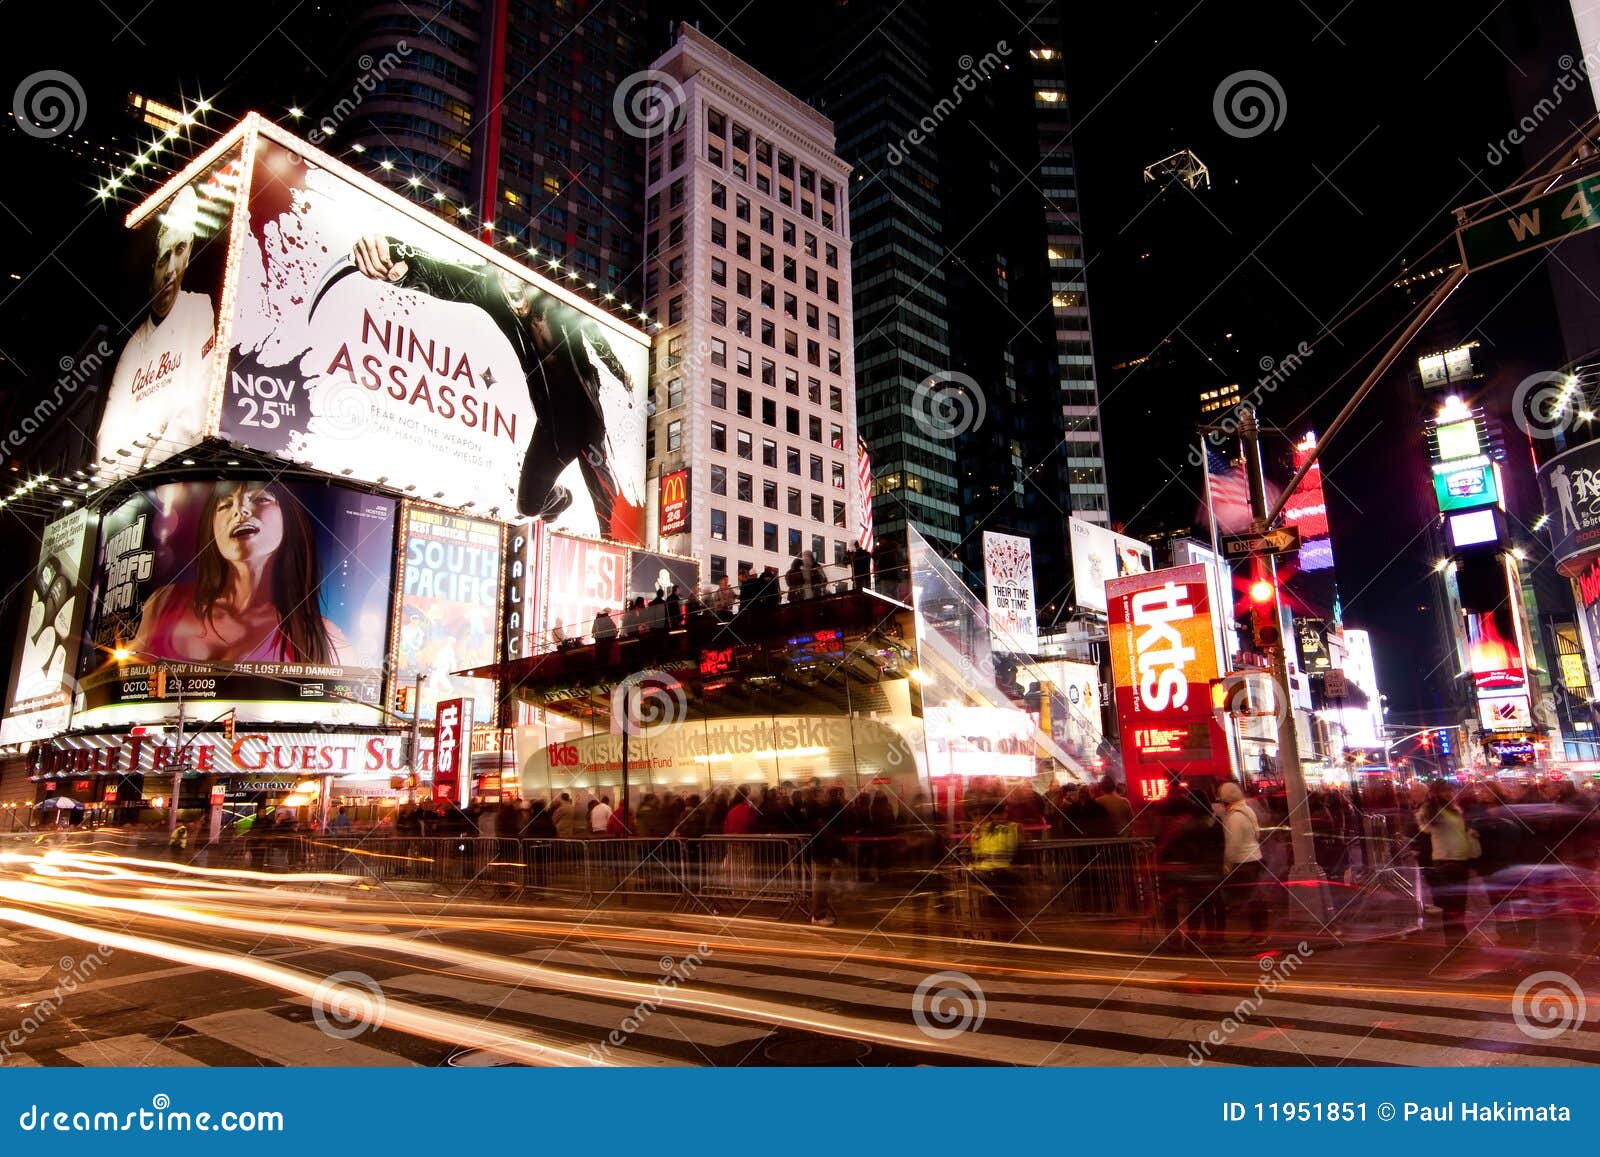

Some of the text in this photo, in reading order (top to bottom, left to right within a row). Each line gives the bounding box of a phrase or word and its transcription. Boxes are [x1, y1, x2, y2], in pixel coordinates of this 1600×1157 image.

[1508, 207, 1541, 242] W
[361, 307, 476, 389] NINJA
[131, 351, 182, 394] Cake Boss
[231, 371, 296, 402] NOV
[326, 342, 517, 444] ASSASSIN
[238, 397, 296, 429] 25TH
[370, 404, 482, 453] FEAR NOT THE WEAPON
[664, 501, 683, 513] OPEN
[667, 509, 681, 523] 24
[662, 519, 685, 532] HOURS
[407, 537, 498, 579] SOUTH
[1233, 535, 1289, 552] ONE WAY
[403, 565, 498, 606] PACIFIC
[992, 585, 1030, 600] THEIR TIME
[996, 597, 1028, 611] OUR TIME
[1132, 581, 1197, 713] tkts
[123, 680, 158, 693] OCTO
[188, 678, 216, 690] 2009
[130, 664, 157, 676] BALLAD
[171, 663, 187, 674] GAY
[234, 663, 254, 674] THE
[254, 664, 279, 675] LOST
[281, 665, 302, 676] AND
[305, 665, 344, 677] DAMNED
[230, 735, 357, 771] GUEST
[363, 736, 436, 772] SUT
[439, 705, 458, 773] tkts
[548, 742, 580, 768] tkts
[605, 758, 652, 772] Devepment
[652, 756, 673, 769] Fund
